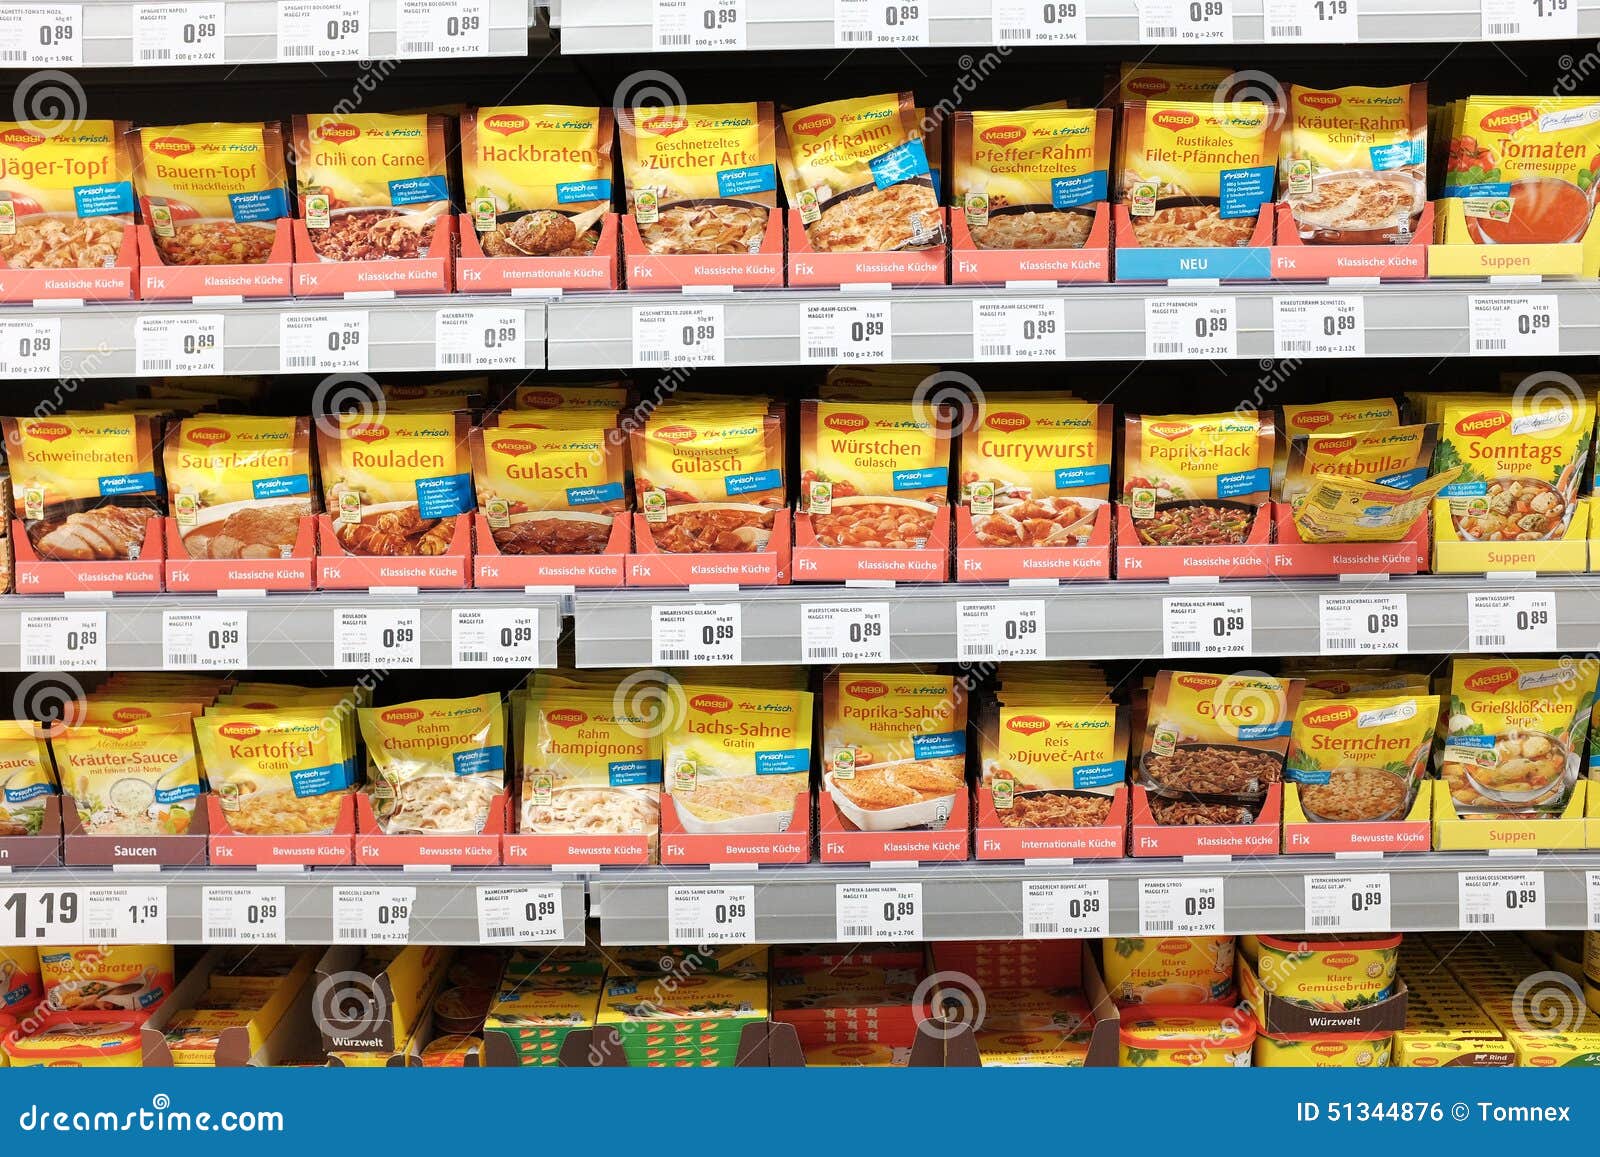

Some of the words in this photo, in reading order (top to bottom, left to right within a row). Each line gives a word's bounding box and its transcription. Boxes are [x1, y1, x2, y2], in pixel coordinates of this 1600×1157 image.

[704, 9, 737, 29] 0.89
[886, 6, 919, 26] 0.89
[1043, 3, 1077, 23] 0.89
[1190, 2, 1223, 21] 0.89
[1314, 1, 1347, 21] 1.19
[184, 23, 216, 43] 0.89
[327, 20, 360, 40] 0.89
[447, 16, 480, 36] 0.89
[40, 25, 73, 46] 0.89
[489, 120, 525, 129] Maggi
[1159, 114, 1195, 125] Maggi
[1298, 116, 1406, 130] Kräuter-Rahm
[1487, 110, 1532, 127] Maggi
[321, 128, 356, 138] Maggi
[985, 131, 1021, 142] Maggi
[1328, 133, 1376, 145] Schnitzel
[656, 138, 740, 152] Geschnetzeltes
[1176, 136, 1233, 148] Rustikales
[1497, 138, 1587, 159] Tomaten
[315, 152, 346, 167] Chili
[352, 154, 376, 166] con
[382, 152, 425, 167] Carne
[482, 144, 593, 163] Hackbraten
[975, 145, 1092, 164] Pfeffer-Rahm
[1146, 149, 1260, 166] Filet-Pfännchen
[0, 157, 109, 180] Jäger-Topf
[157, 164, 257, 182] Bauern-Topf
[991, 162, 1077, 174] Geschnetzeltes
[1504, 160, 1577, 174] Cremesuppe
[173, 183, 188, 191] mit
[191, 182, 245, 191] Hackfleisch
[1180, 258, 1208, 271] NEU
[1277, 257, 1296, 269] Fix
[1337, 257, 1385, 267] Klassische
[1388, 255, 1418, 267] Küche
[1480, 254, 1531, 268] Suppen
[147, 277, 165, 289] Fix
[204, 276, 251, 287] Klassische
[254, 275, 283, 286] Küche
[463, 269, 481, 281] Fix
[503, 269, 571, 279] Internationale
[574, 267, 604, 279] Küche
[851, 321, 884, 341] 0.89
[1024, 319, 1056, 339] 0.89
[1195, 317, 1228, 337] 0.89
[1323, 315, 1355, 335] 0.89
[1518, 314, 1550, 334] 0.89
[328, 331, 360, 350] 0.89
[484, 327, 516, 348] 0.89
[682, 325, 715, 345] 0.89
[19, 337, 51, 357] 0.89
[184, 334, 215, 354] 0.89
[830, 418, 864, 428] Maggi
[991, 417, 1026, 427] Maggi
[1462, 414, 1506, 431] Maggi
[497, 440, 533, 451] Maggi
[672, 446, 739, 458] Ungarisches
[831, 439, 922, 457] Würstchen
[981, 440, 1094, 461] Currywurst
[1150, 443, 1251, 460] Paprika-Hack
[1469, 441, 1562, 465] Sonntags
[27, 450, 134, 464] Schweinebraten
[182, 452, 289, 469] Sauerbraten
[352, 450, 444, 468] Rouladen
[854, 457, 897, 469] Gulasch
[1311, 455, 1411, 476] Köttbullar
[505, 463, 588, 480] Gulasch
[671, 457, 742, 475] Gulasch
[1180, 460, 1218, 472] Pfanne
[1496, 460, 1532, 473] Suppe
[964, 559, 982, 571] Fix
[1023, 558, 1070, 569] Klassische
[1073, 556, 1102, 568] Küche
[1487, 551, 1536, 564] Suppen
[1213, 616, 1244, 636] 0.89
[1367, 613, 1399, 633] 0.89
[1517, 610, 1548, 630] 0.89
[501, 627, 532, 647] 0.89
[702, 625, 734, 645] 0.89
[850, 622, 882, 642] 0.89
[1005, 619, 1037, 639] 0.89
[67, 631, 97, 650] 0.89
[208, 630, 239, 649] 0.89
[383, 628, 413, 648] 0.89
[695, 698, 729, 710] Maggi
[1196, 701, 1253, 719] Gyros
[1471, 700, 1573, 717] Grießklößchen
[843, 705, 949, 722] Paprika-Sahne
[1309, 711, 1352, 726] Maggi
[1505, 715, 1538, 728] Suppe
[417, 724, 450, 735] Rahm
[688, 720, 792, 739] Lachs-Sahne
[869, 721, 922, 734] Hähnchen
[1012, 720, 1046, 731] Maggi
[577, 728, 610, 741] Rahm
[1045, 736, 1069, 748] Reis
[1311, 733, 1412, 753] Sternchen
[230, 740, 314, 759] Kartoffel
[723, 738, 755, 750] Gratin
[69, 752, 178, 767] Kräuter-Sauce
[1343, 750, 1377, 762] Suppe
[258, 760, 289, 771] Gratin
[983, 839, 1001, 851] Fix
[1021, 838, 1086, 850] Internationale
[1088, 837, 1117, 849] Küche
[1489, 829, 1536, 842] Suppen
[114, 845, 157, 857] Saucen
[362, 846, 379, 857] Fix
[419, 846, 462, 857] Bewusste
[465, 845, 493, 856] Küche
[1185, 896, 1216, 916] 0.89
[1351, 892, 1382, 911] 0.89
[1506, 889, 1537, 909] 0.89
[3, 892, 78, 938] 1.19
[128, 905, 158, 924] 1.19
[247, 904, 277, 924] 0.89
[378, 904, 408, 924] 0.89
[525, 901, 555, 921] 0.89
[715, 904, 746, 924] 0.89
[883, 901, 914, 921] 0.89
[1069, 899, 1100, 918] 0.89
[1327, 974, 1352, 984] Klare
[1309, 1016, 1361, 1027] Würzwelt
[332, 1036, 384, 1048] Würzwelt
[1489, 1053, 1508, 1062] Rind
